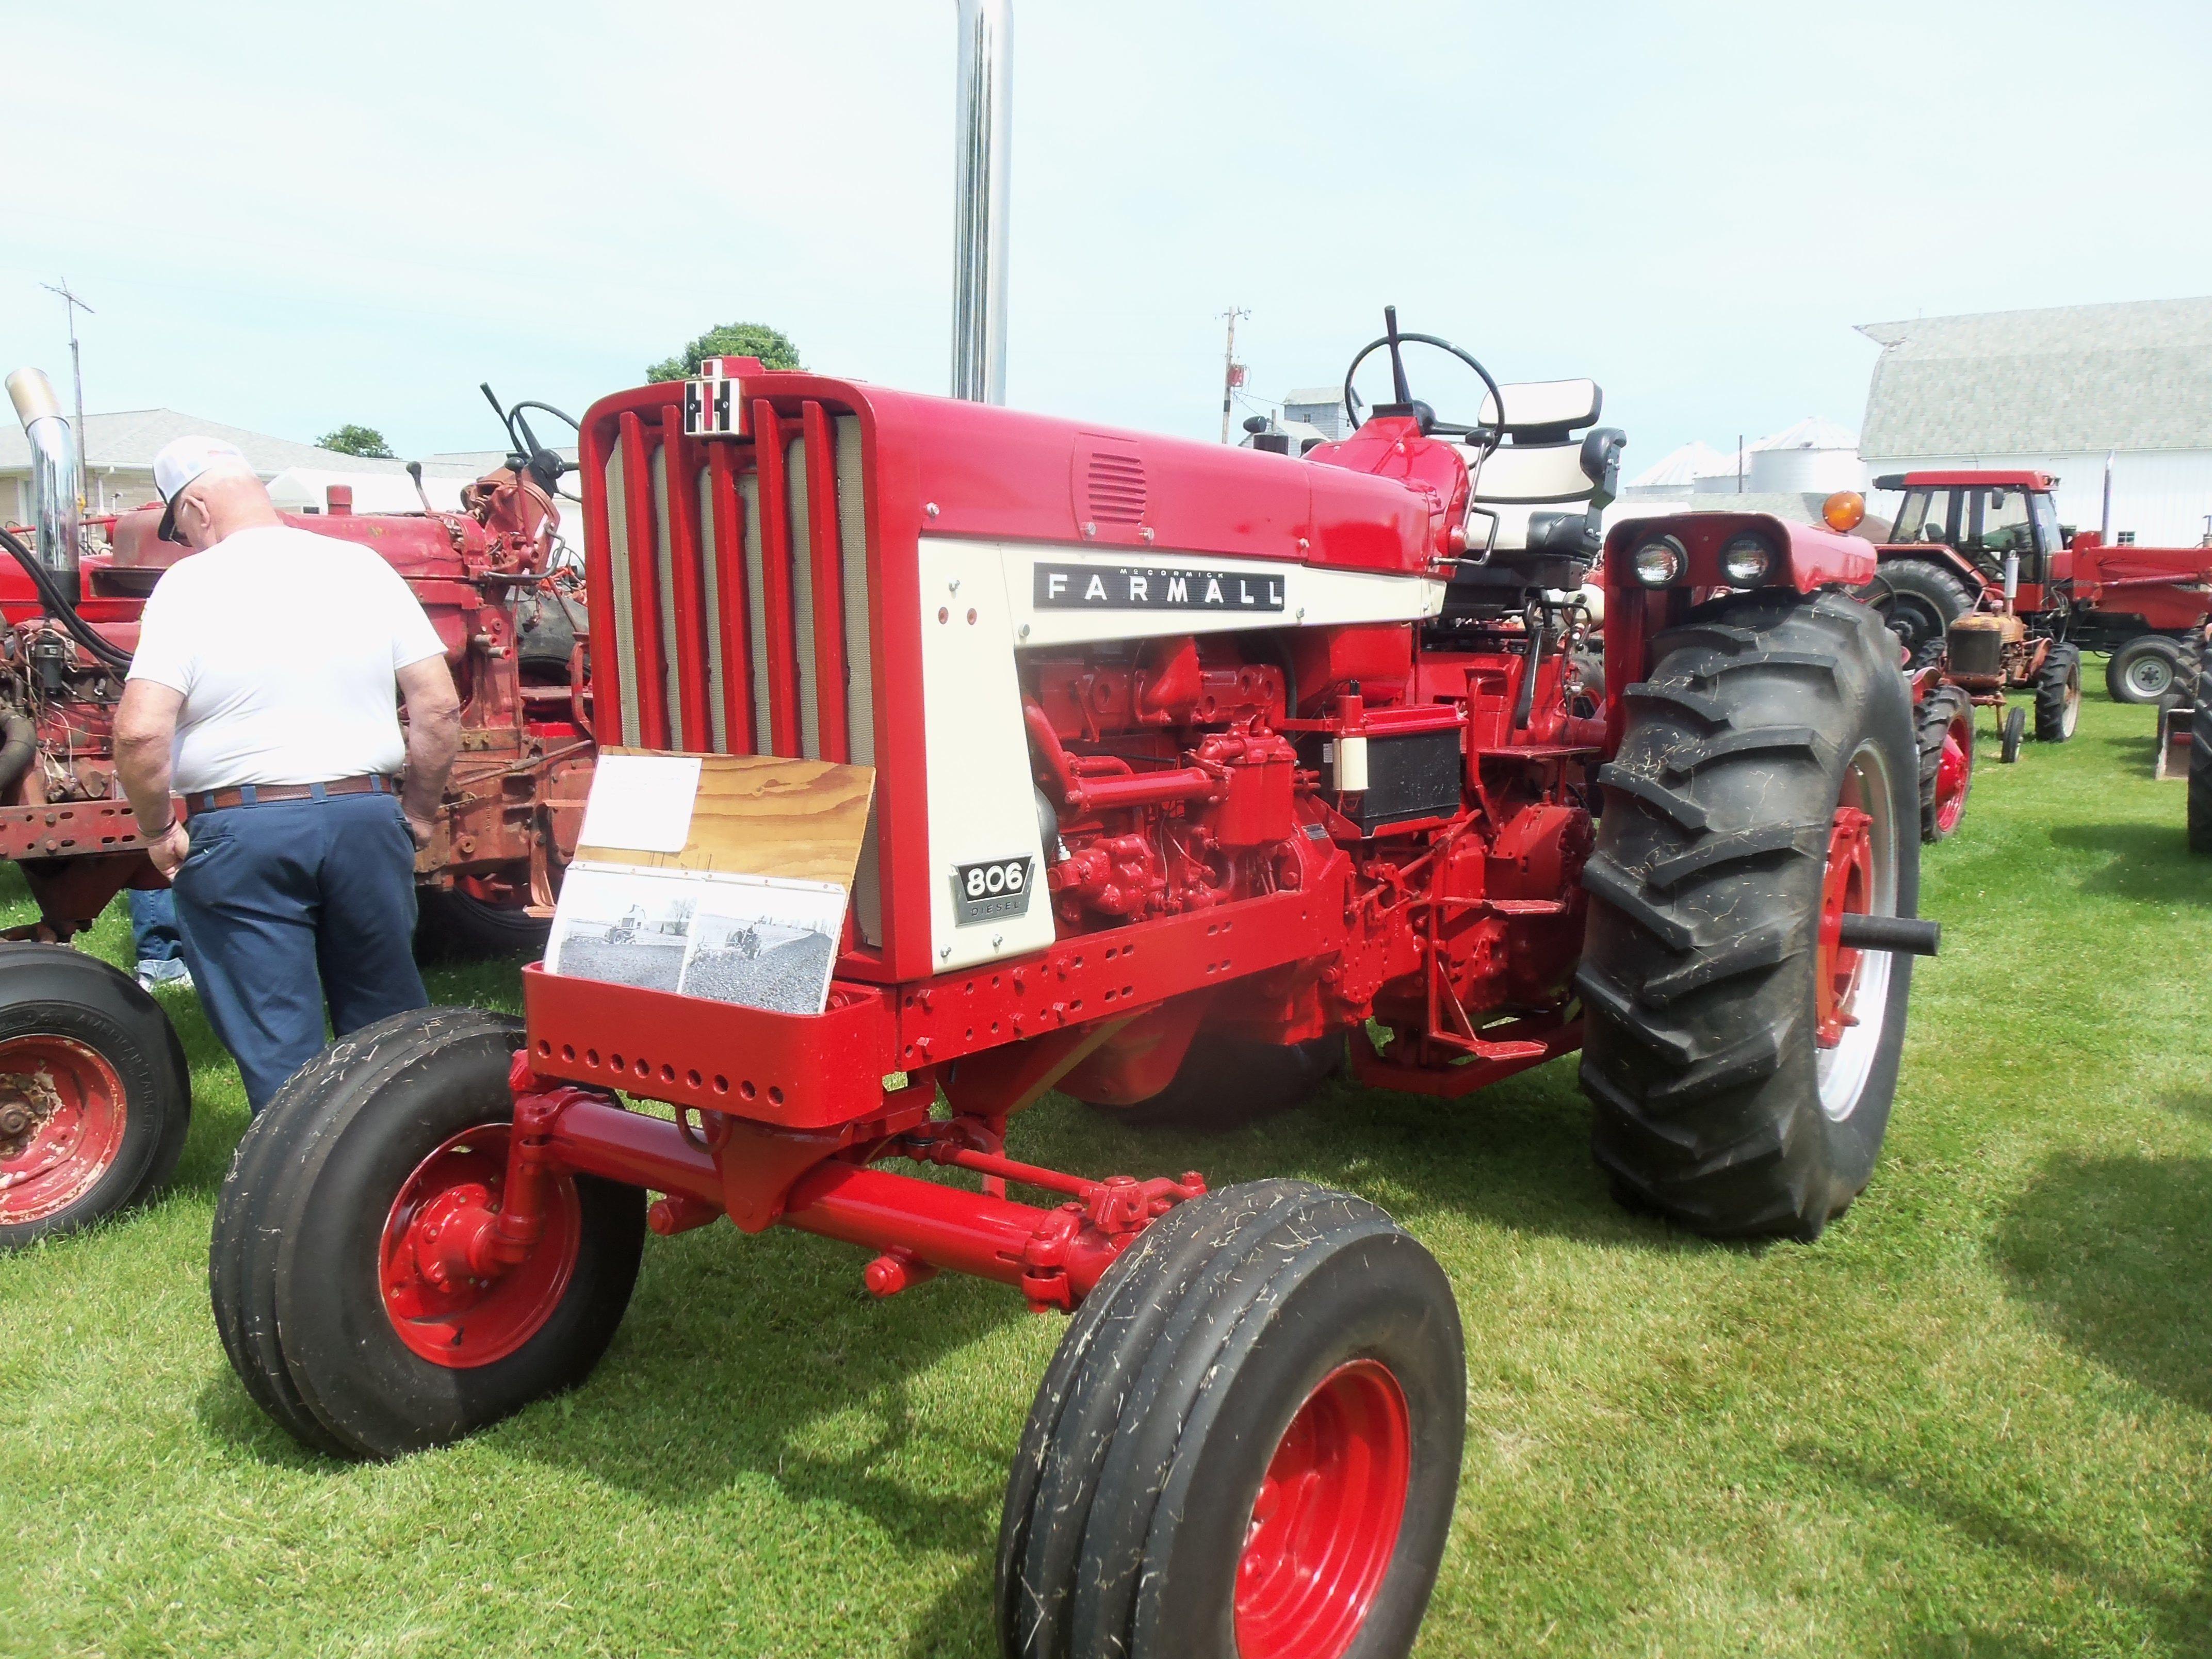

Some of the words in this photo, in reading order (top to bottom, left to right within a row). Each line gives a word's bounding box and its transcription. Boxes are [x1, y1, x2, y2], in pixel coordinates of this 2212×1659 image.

[1049, 574, 1282, 604] FARMALL
[967, 861, 1023, 896] 806
[971, 901, 1020, 916] DIESEL
